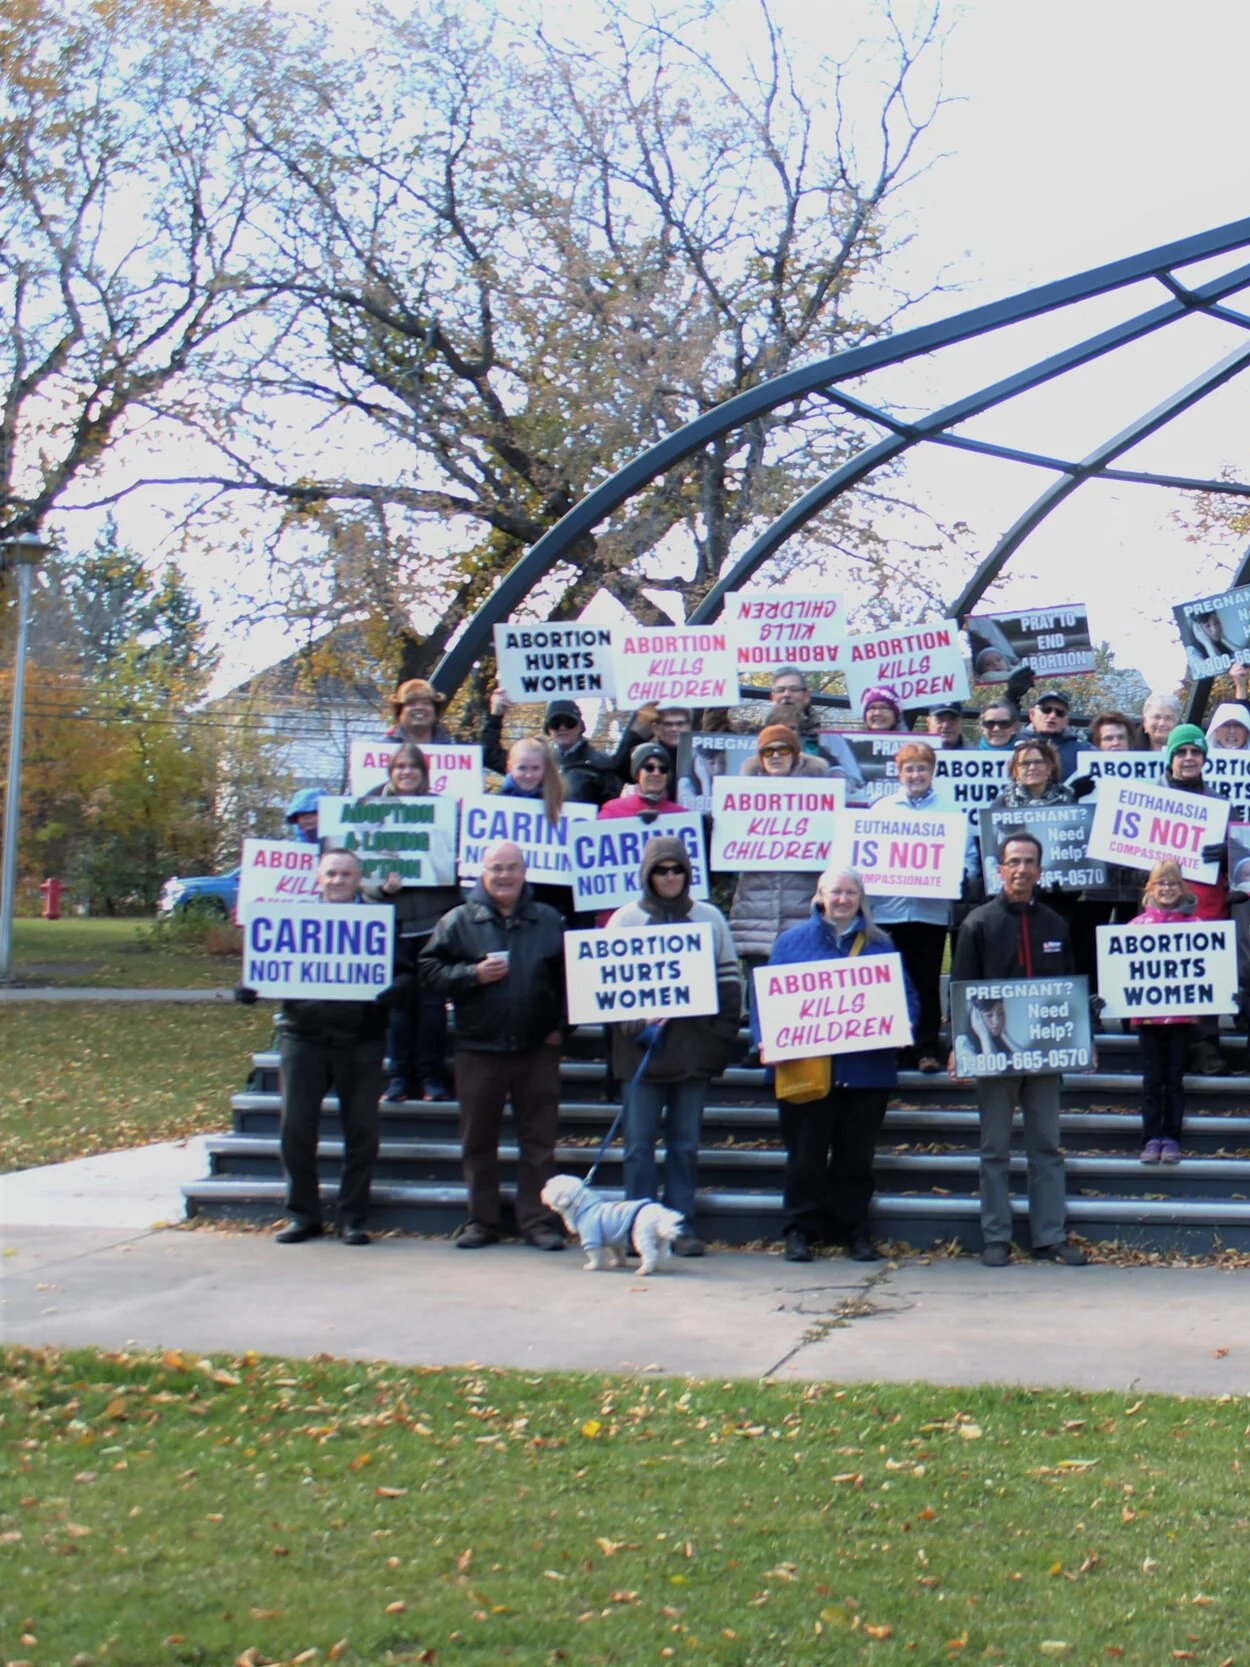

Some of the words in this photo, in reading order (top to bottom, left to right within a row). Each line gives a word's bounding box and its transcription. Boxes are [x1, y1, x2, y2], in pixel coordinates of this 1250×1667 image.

[737, 600, 837, 620] CHILDREN
[1021, 613, 1055, 632] PRAY
[1056, 610, 1076, 627] TO
[505, 629, 611, 649] ABORTION
[759, 623, 816, 641] KILLS
[1037, 633, 1065, 650] END
[623, 634, 726, 654] ABORTION
[851, 630, 951, 662] ABORTION
[525, 652, 594, 671] HURTS
[737, 645, 839, 664] ABORTION
[1021, 651, 1087, 671] ABORTION
[648, 658, 703, 677] KILLS
[877, 655, 932, 681] KILLS
[521, 674, 602, 692] WOMEN
[627, 679, 726, 701] CHILDREN
[723, 793, 835, 812] ABORTION
[1119, 789, 1208, 821] EUTHANASIA
[341, 803, 435, 824] ADOPTION
[992, 808, 1087, 825] PREGNANT?
[747, 817, 809, 836] KILLS
[854, 820, 946, 837] EUTHANASIA
[1047, 826, 1085, 841] Need
[1112, 809, 1142, 839] IS
[1149, 816, 1206, 852] NOT
[723, 841, 832, 860] CHILDREN
[852, 840, 878, 867] IS
[889, 841, 944, 870] NOT
[1050, 844, 1087, 861] Help?
[578, 872, 617, 896] NOT
[251, 917, 387, 956] CARING
[578, 933, 702, 960] ABORTION
[1108, 931, 1226, 955] ABORTION
[249, 960, 293, 981] NOT
[301, 961, 386, 985] KILLING
[601, 961, 681, 984] HURTS
[1129, 958, 1206, 980] HURTS
[768, 964, 891, 996] ABORTION
[595, 985, 691, 1011] WOMEN
[965, 981, 1074, 1000] PREGNANT?
[1123, 983, 1214, 1006] WOMEN
[800, 993, 865, 1020] KILLS
[1027, 1001, 1069, 1019] Need
[775, 1015, 894, 1049] CHILDREN
[1029, 1021, 1074, 1041] Help?
